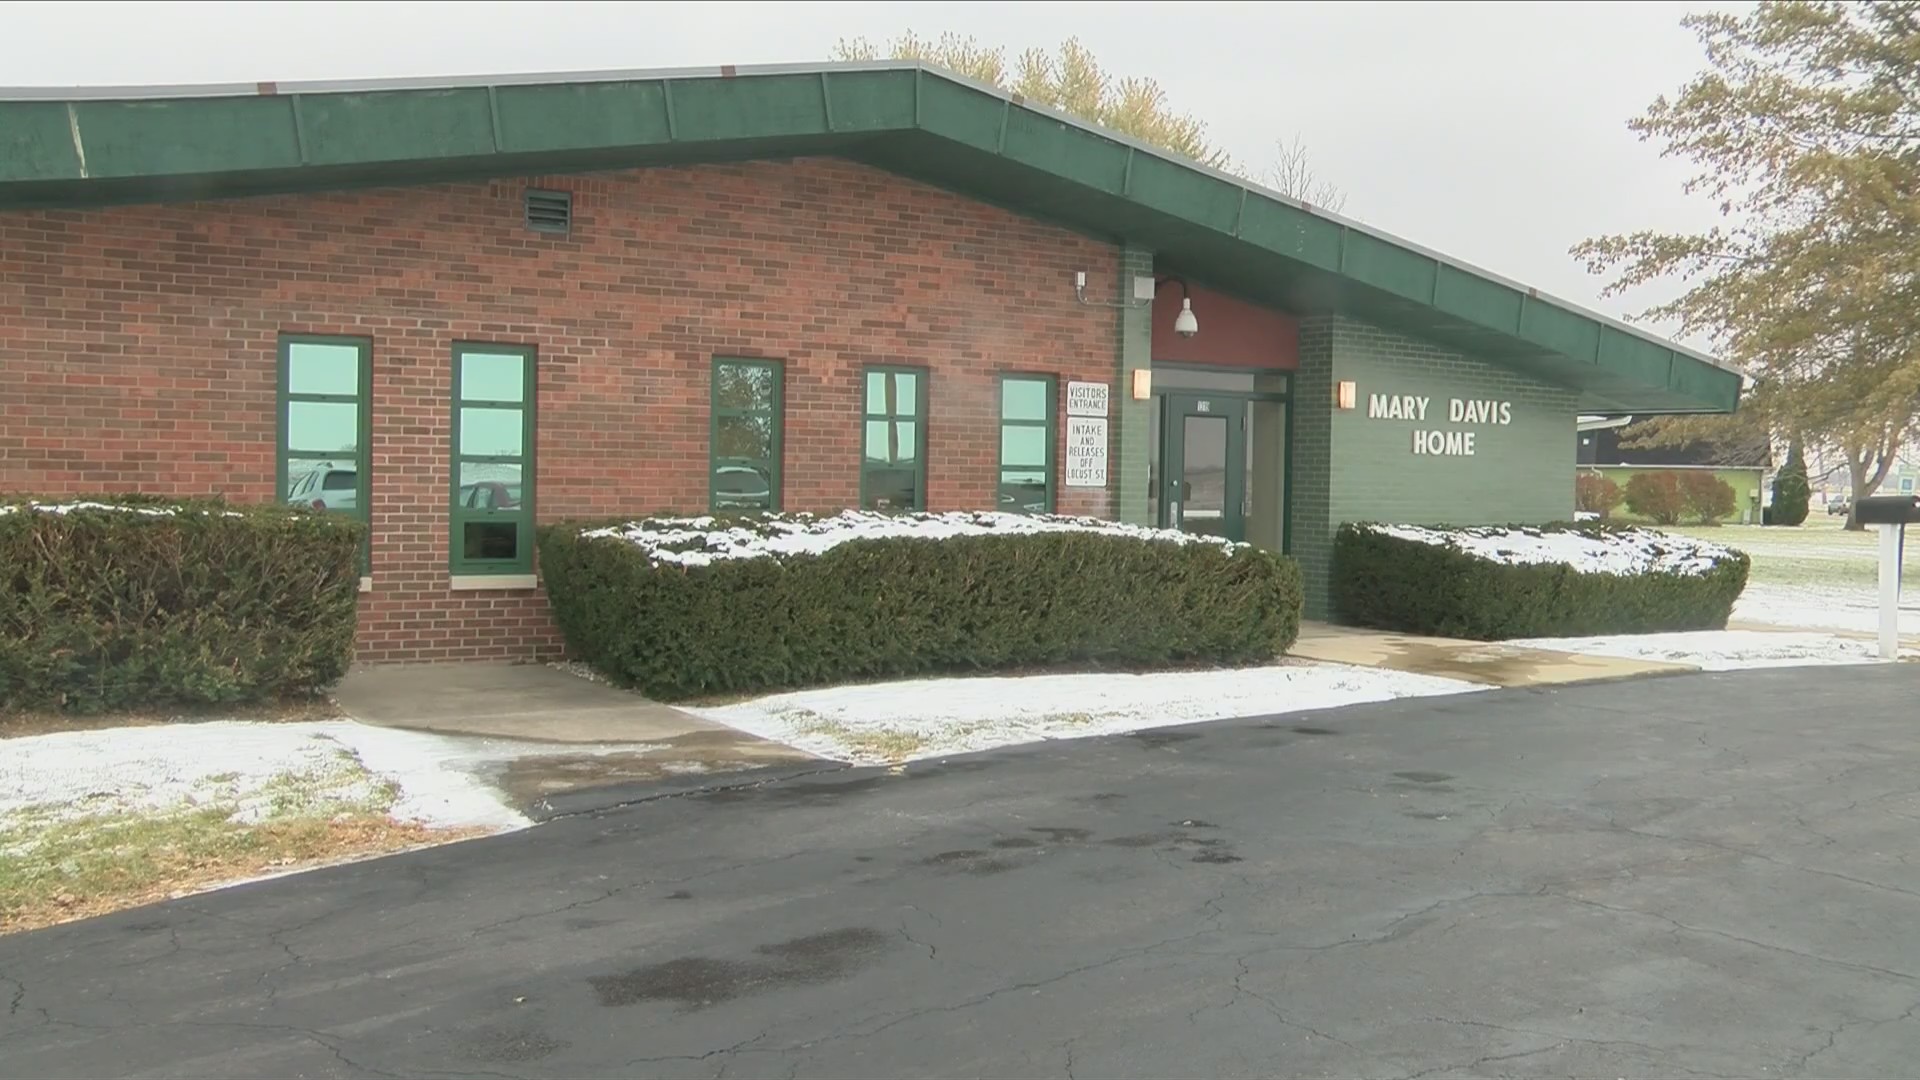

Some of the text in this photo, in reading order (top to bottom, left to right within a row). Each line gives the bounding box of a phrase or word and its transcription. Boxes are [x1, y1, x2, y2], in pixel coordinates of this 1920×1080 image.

[1069, 387, 1107, 399] VISITORS
[1069, 399, 1106, 410] ENTRANCE
[1368, 394, 1512, 425] MARY DAVIS
[1072, 425, 1102, 436] INTAKE
[1080, 437, 1095, 446] AND
[1412, 429, 1476, 456] HOME
[1069, 447, 1105, 457] RELEASES
[1080, 458, 1093, 468] OFF
[1067, 468, 1093, 479] LOCUST
